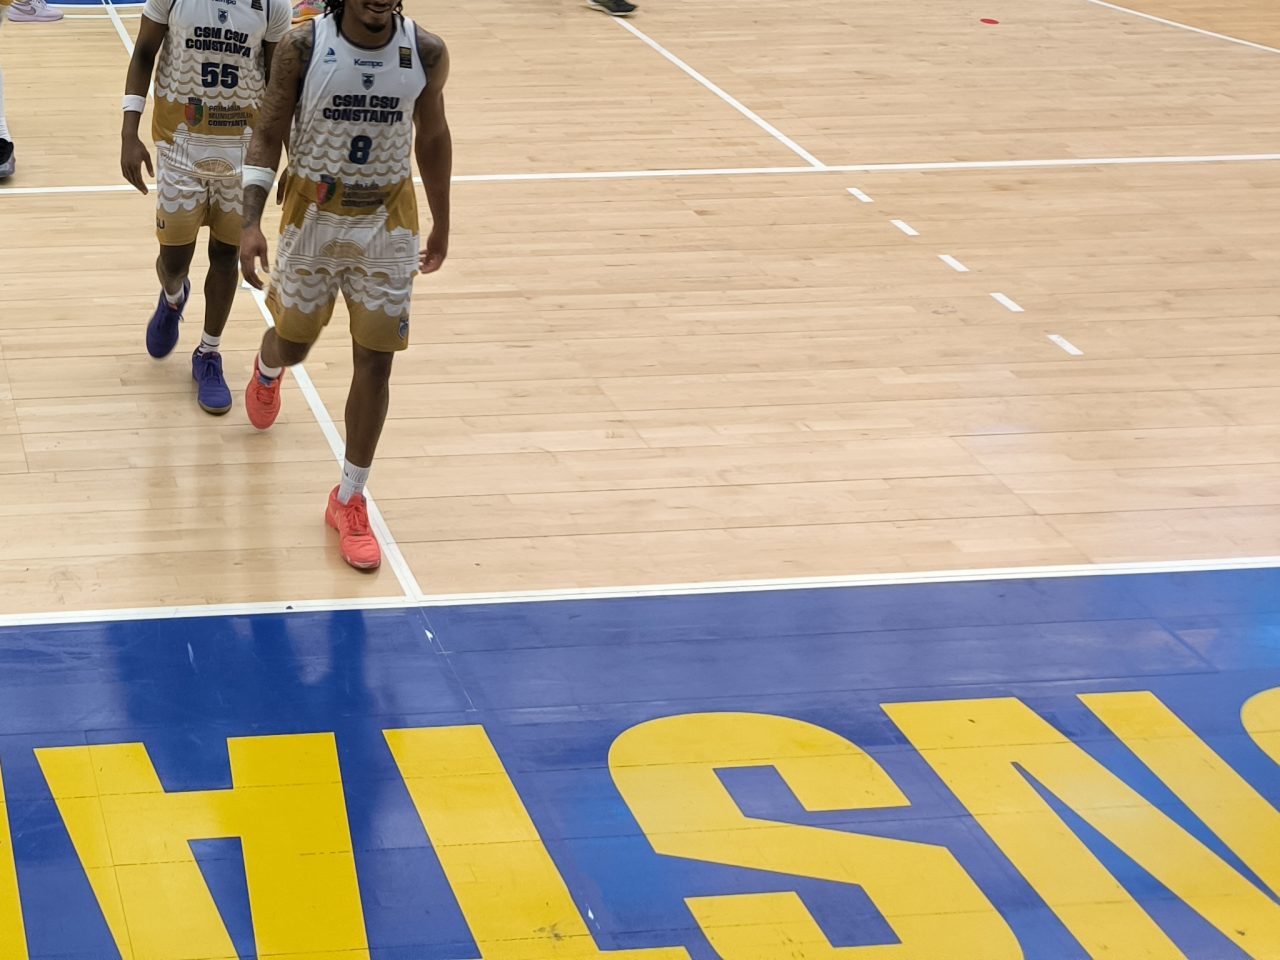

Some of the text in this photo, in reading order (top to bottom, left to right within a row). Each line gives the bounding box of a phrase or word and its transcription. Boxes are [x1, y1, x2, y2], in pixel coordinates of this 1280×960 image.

[194, 26, 248, 44] CSM CSU
[201, 61, 239, 89] 55
[333, 95, 400, 110] CSM CSU
[349, 135, 373, 165] 8
